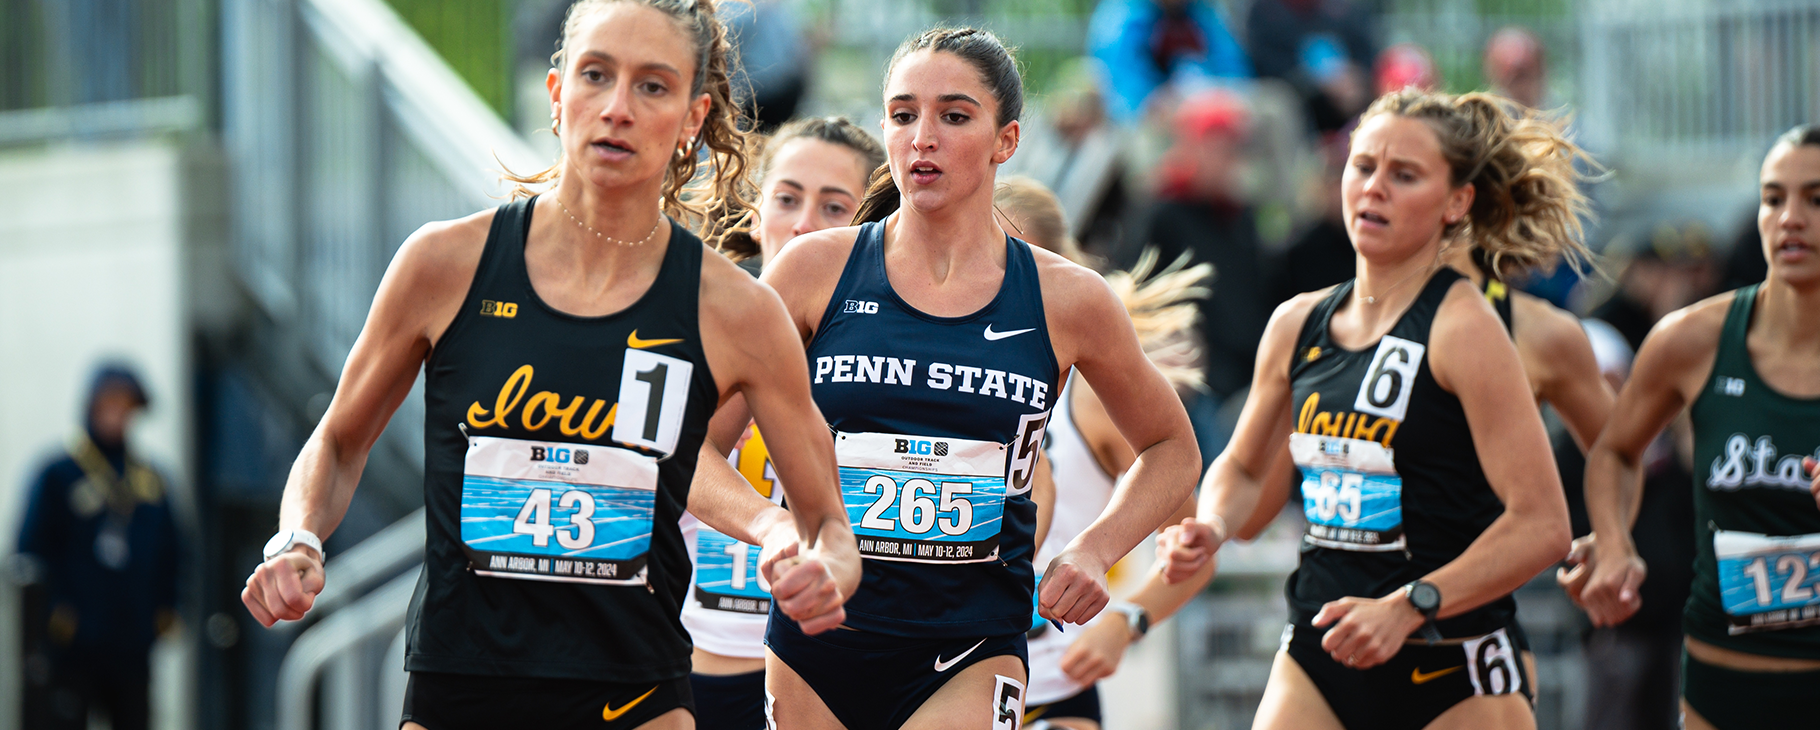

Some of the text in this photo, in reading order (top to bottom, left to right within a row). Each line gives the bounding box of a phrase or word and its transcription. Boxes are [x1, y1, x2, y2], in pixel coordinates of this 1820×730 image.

[467, 364, 649, 448] Iow
[635, 361, 668, 443] 1
[814, 355, 1048, 411] PENN STATE
[1367, 346, 1409, 408] 6
[1012, 418, 1047, 492] 5
[513, 486, 596, 551] 43
[860, 474, 974, 537] 265
[1315, 469, 1364, 521] 65
[489, 554, 508, 569] ANN
[538, 558, 550, 572] MI
[555, 559, 573, 574] MAY
[596, 562, 618, 577] 2024
[859, 539, 974, 558] ANN ARBOR, MI MAY 10-12, 2024
[1476, 635, 1511, 695] 6
